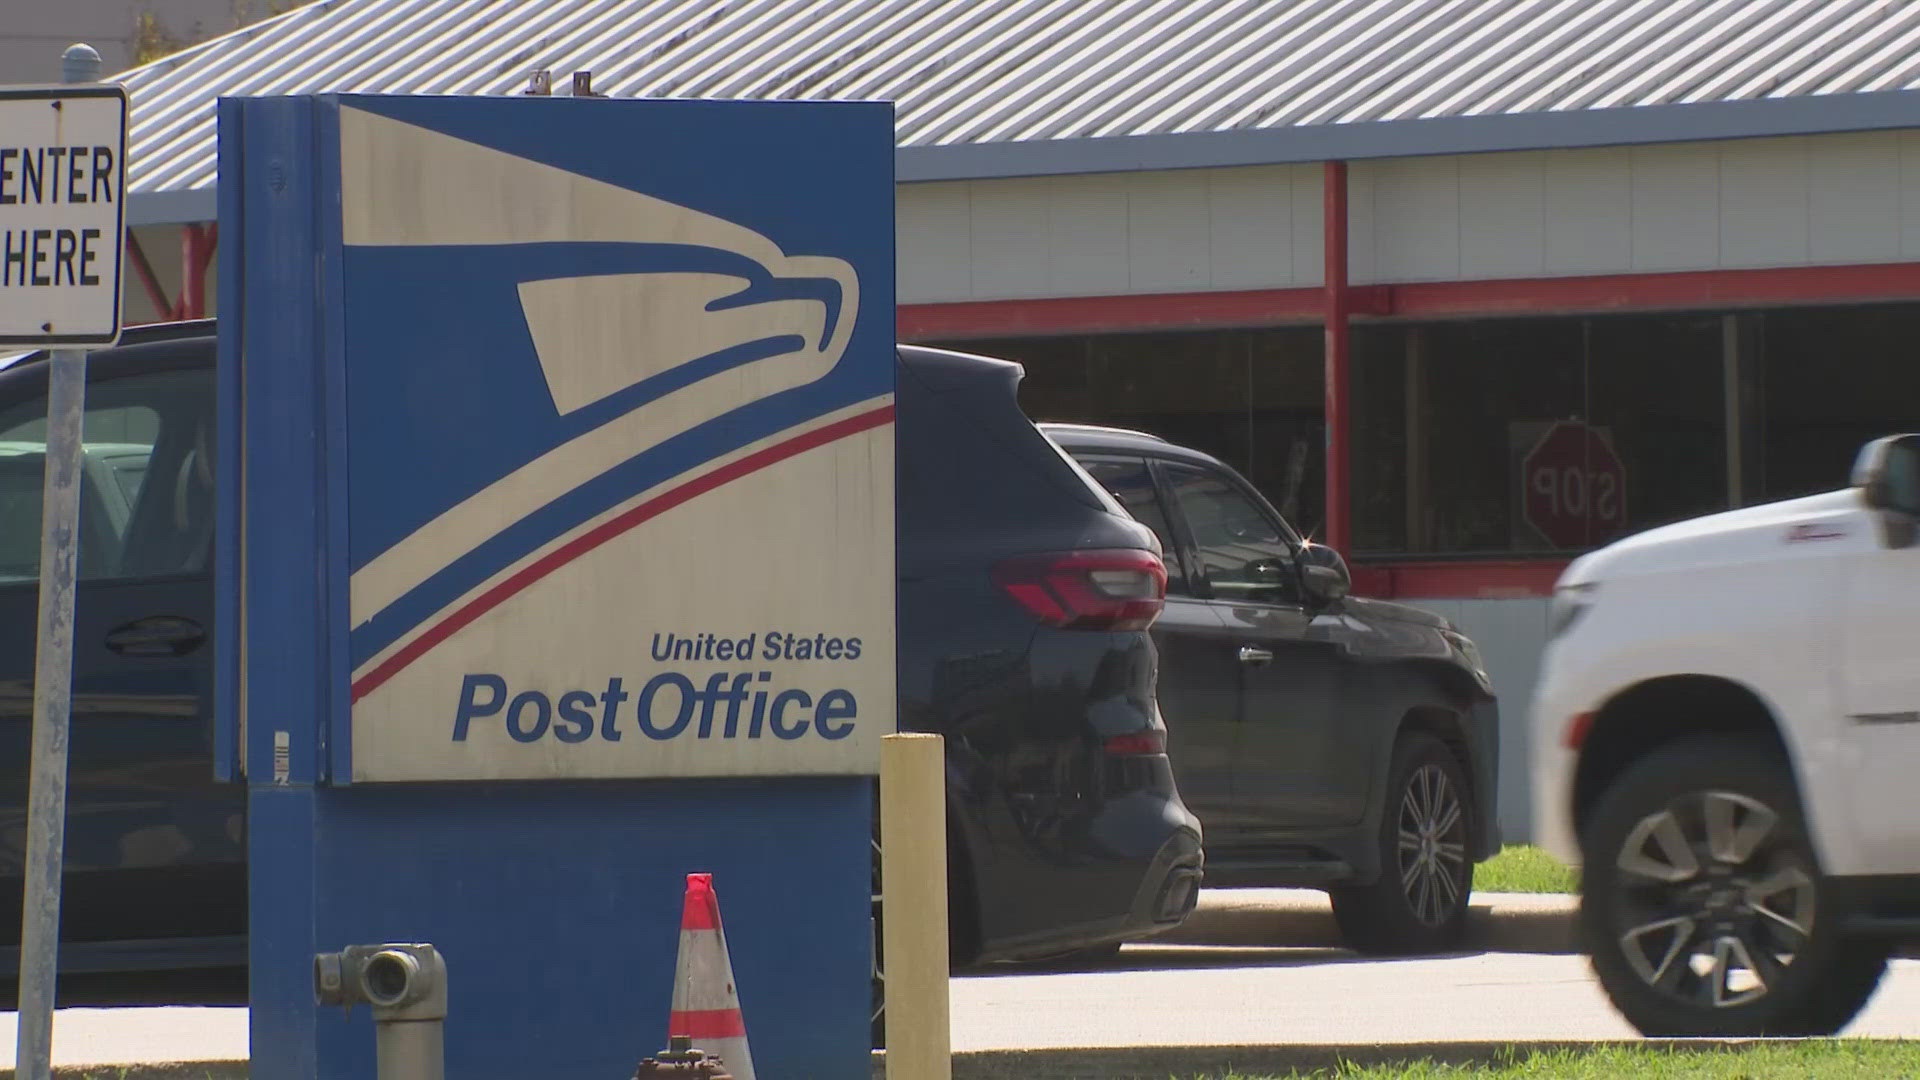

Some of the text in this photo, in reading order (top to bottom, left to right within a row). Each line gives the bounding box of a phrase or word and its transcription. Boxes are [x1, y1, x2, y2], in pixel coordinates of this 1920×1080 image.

[0, 146, 113, 204] ENTER
[4, 229, 100, 286] HERE
[651, 631, 862, 661] United States
[452, 671, 857, 744] Post Office
